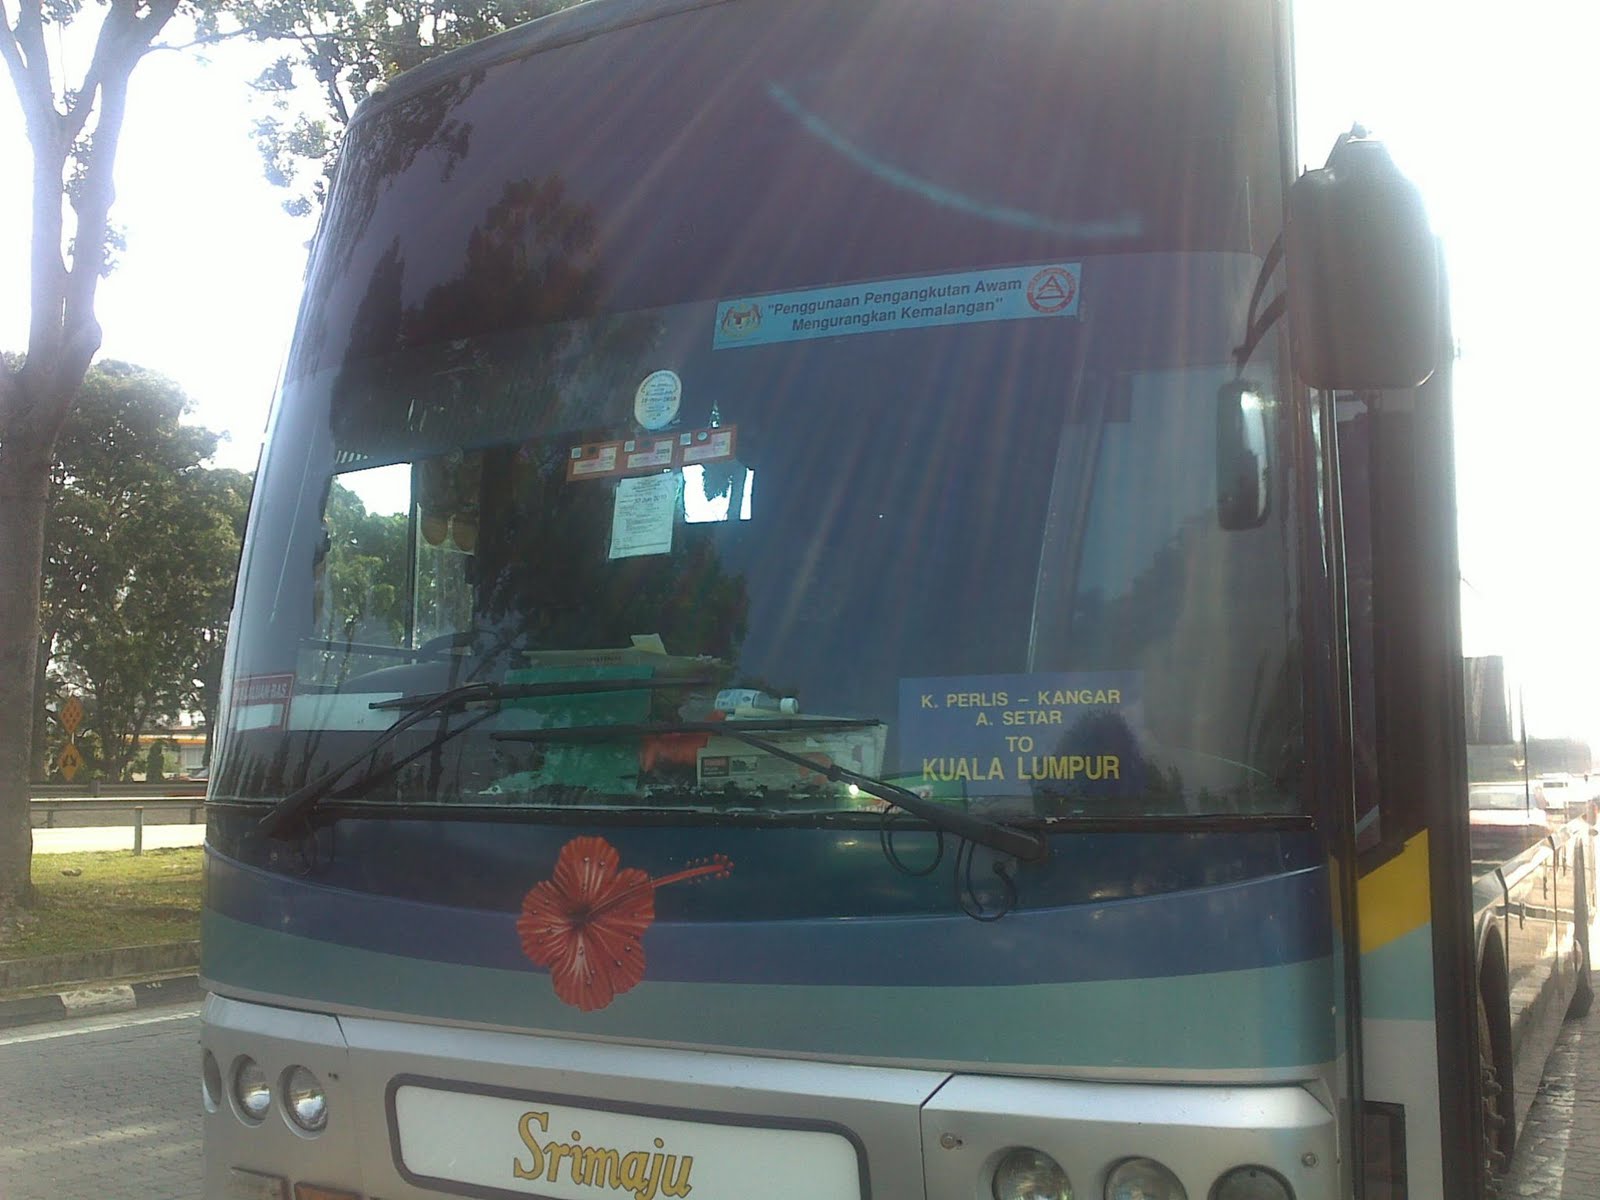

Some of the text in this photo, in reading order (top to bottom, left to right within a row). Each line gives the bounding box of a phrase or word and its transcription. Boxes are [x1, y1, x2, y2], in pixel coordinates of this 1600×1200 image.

[768, 294, 860, 317] "Penggunaan
[864, 283, 970, 307] Pengangkutan
[974, 277, 1022, 294] Awam
[791, 297, 1003, 331] Mengurangkan Kemalangan"
[921, 694, 939, 708] K.
[946, 691, 1009, 708] PERLIS
[1038, 689, 1121, 706] KANGAR
[975, 710, 1063, 726] A. SETAR
[1005, 736, 1034, 753] TO
[922, 755, 1120, 782] KUALA LUMPUR
[513, 1111, 693, 1200] Srimaju
